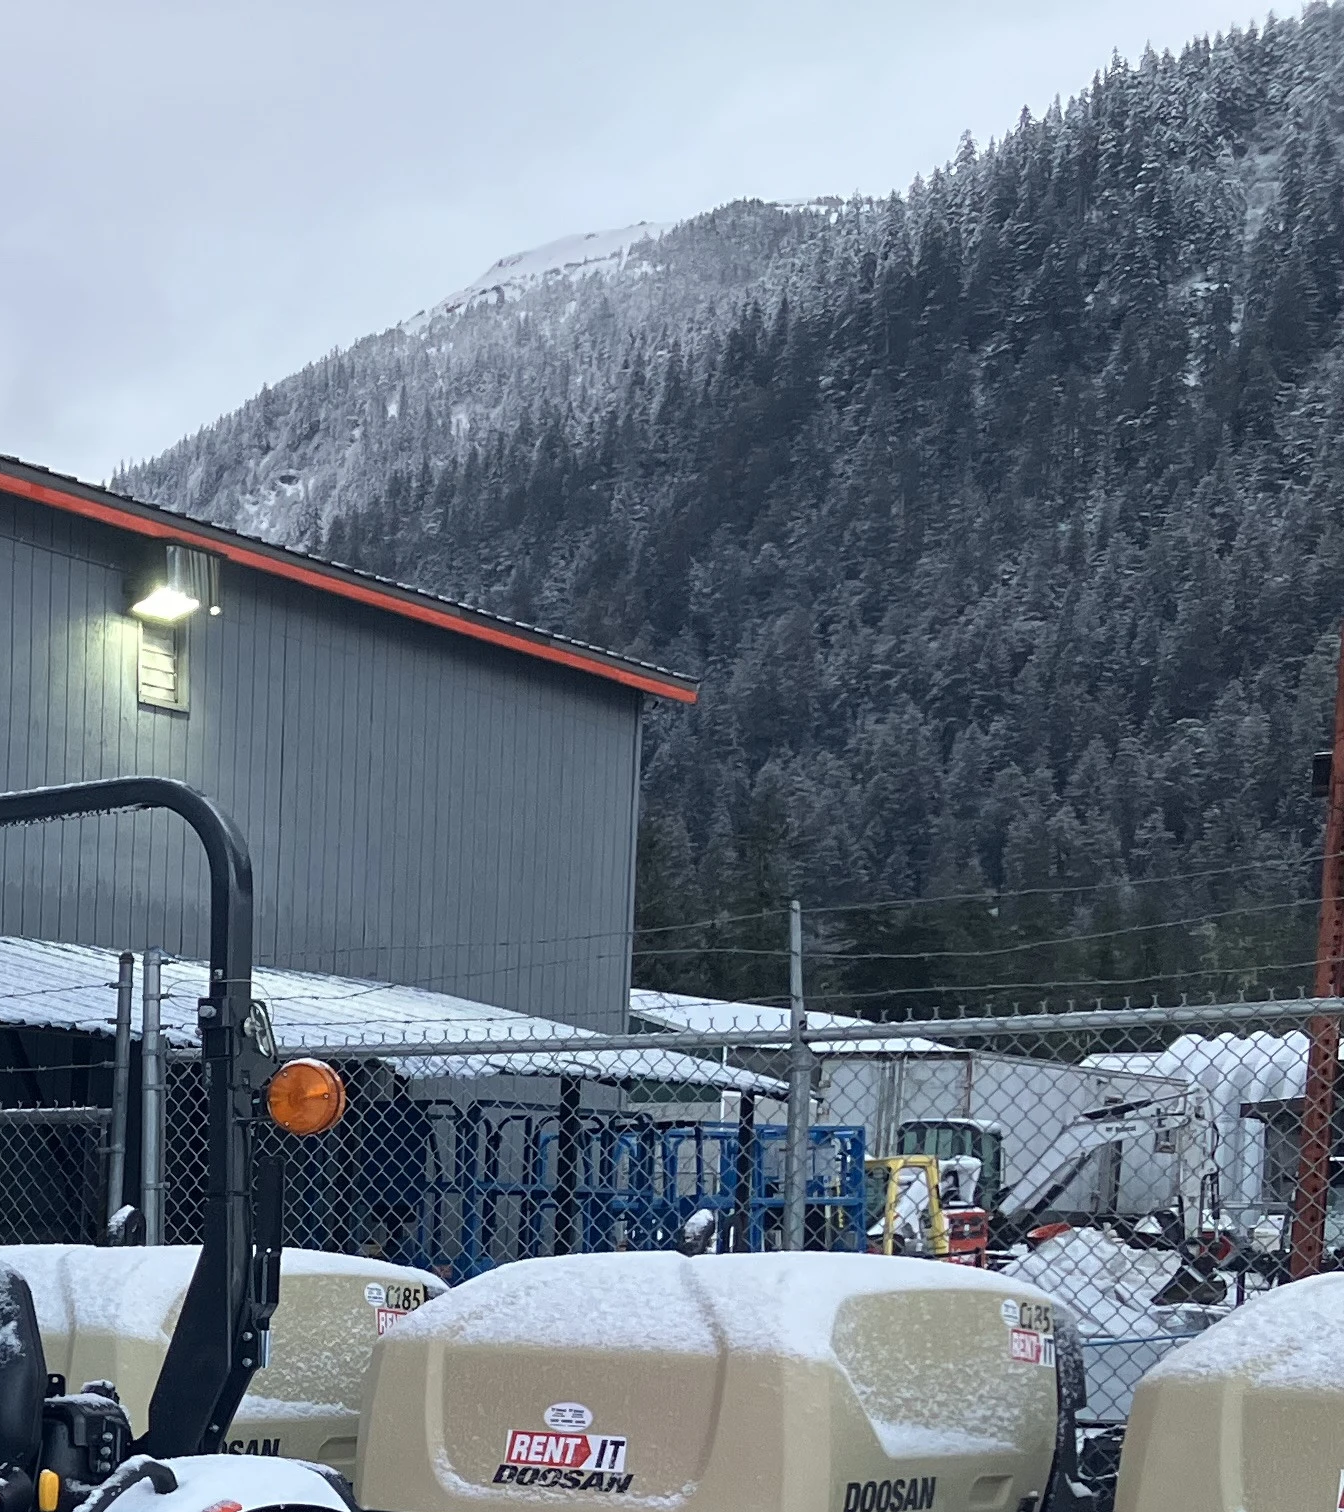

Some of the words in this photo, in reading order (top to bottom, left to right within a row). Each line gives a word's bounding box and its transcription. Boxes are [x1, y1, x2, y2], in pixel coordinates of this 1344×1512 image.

[387, 1284, 421, 1311] C185
[511, 1434, 581, 1464] RENT
[595, 1439, 625, 1469] IT
[492, 1464, 635, 1494] DOOSAN
